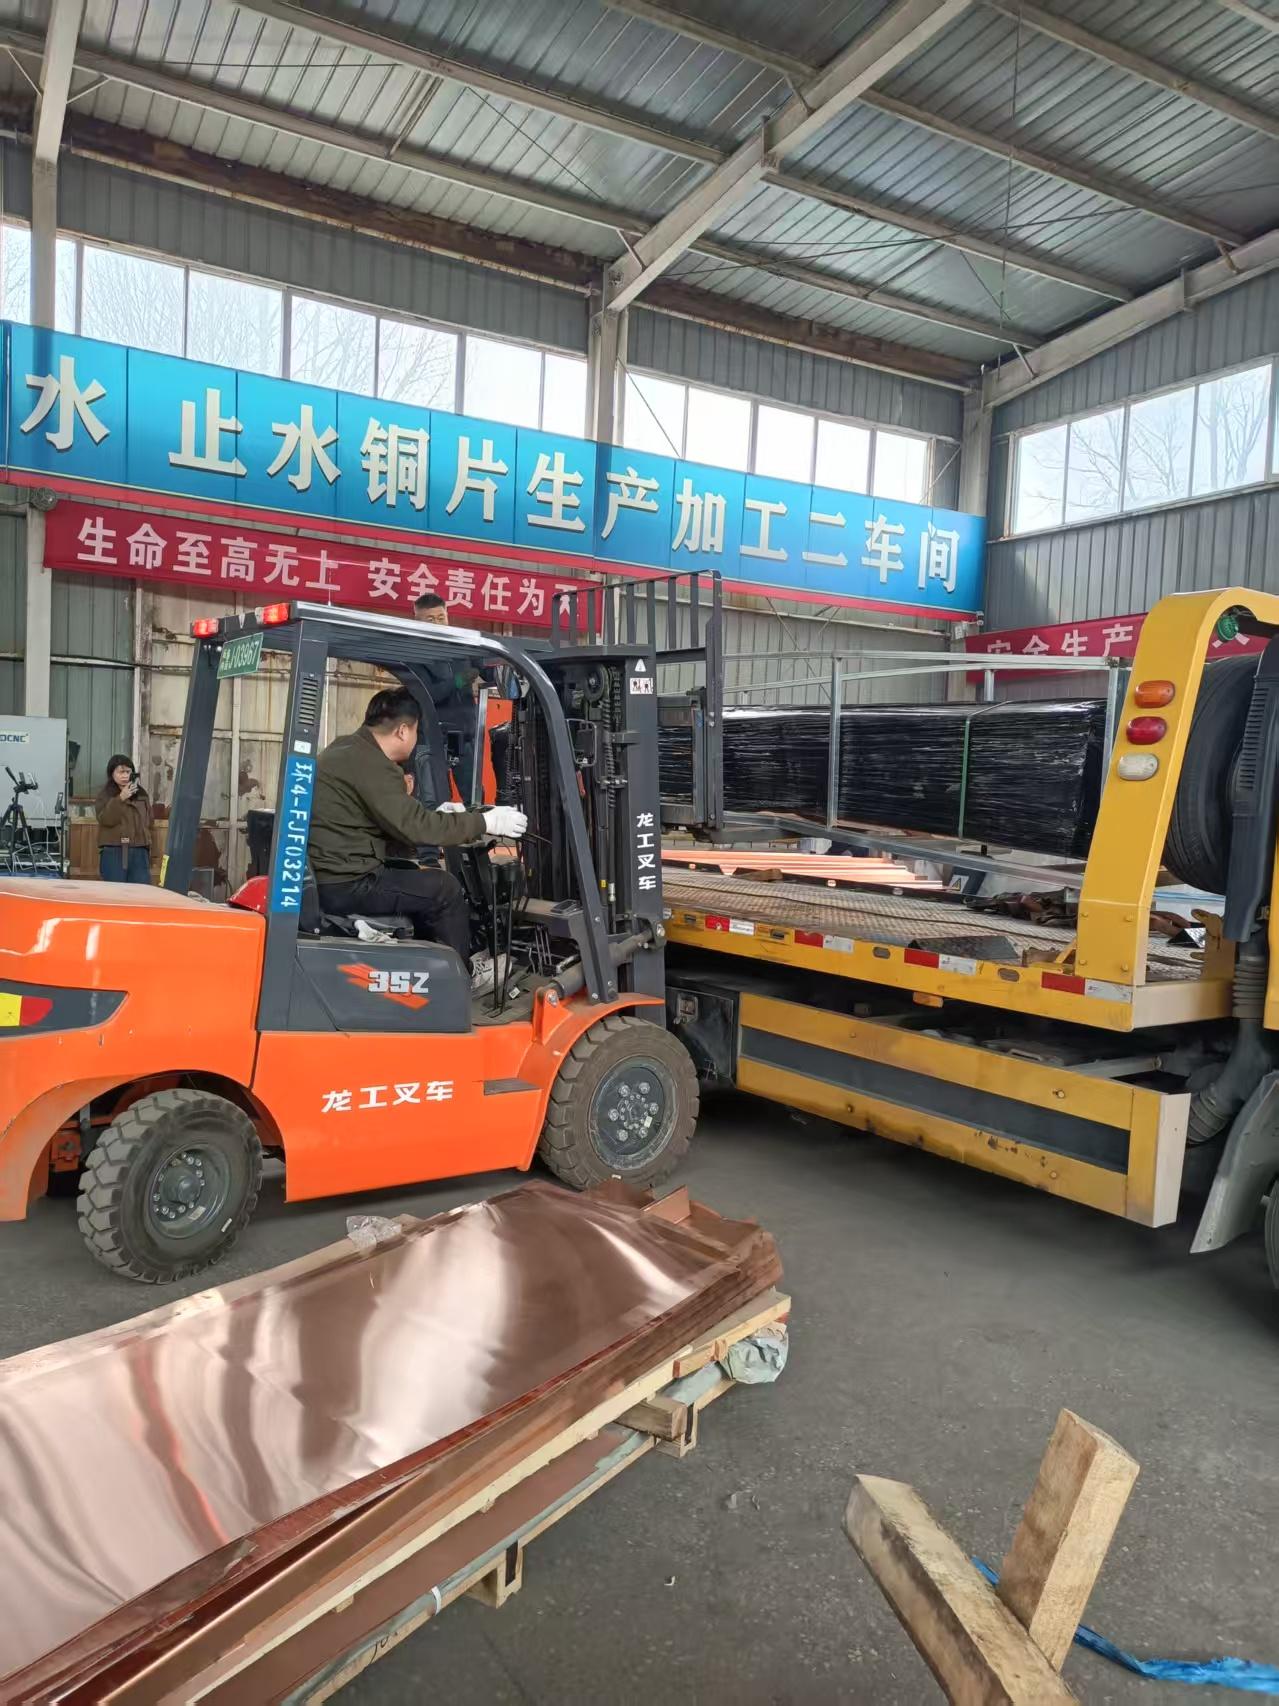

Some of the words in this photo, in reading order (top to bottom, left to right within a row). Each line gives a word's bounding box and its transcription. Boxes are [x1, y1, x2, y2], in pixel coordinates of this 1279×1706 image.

[20, 354, 111, 450] 水
[168, 387, 960, 593] 止水铜片生产加工二车间
[77, 516, 341, 591] 生命至高无上
[636, 812, 657, 891] 龙工叉车
[368, 971, 430, 993] 35Z
[321, 1080, 454, 1113] 龙工叉车
